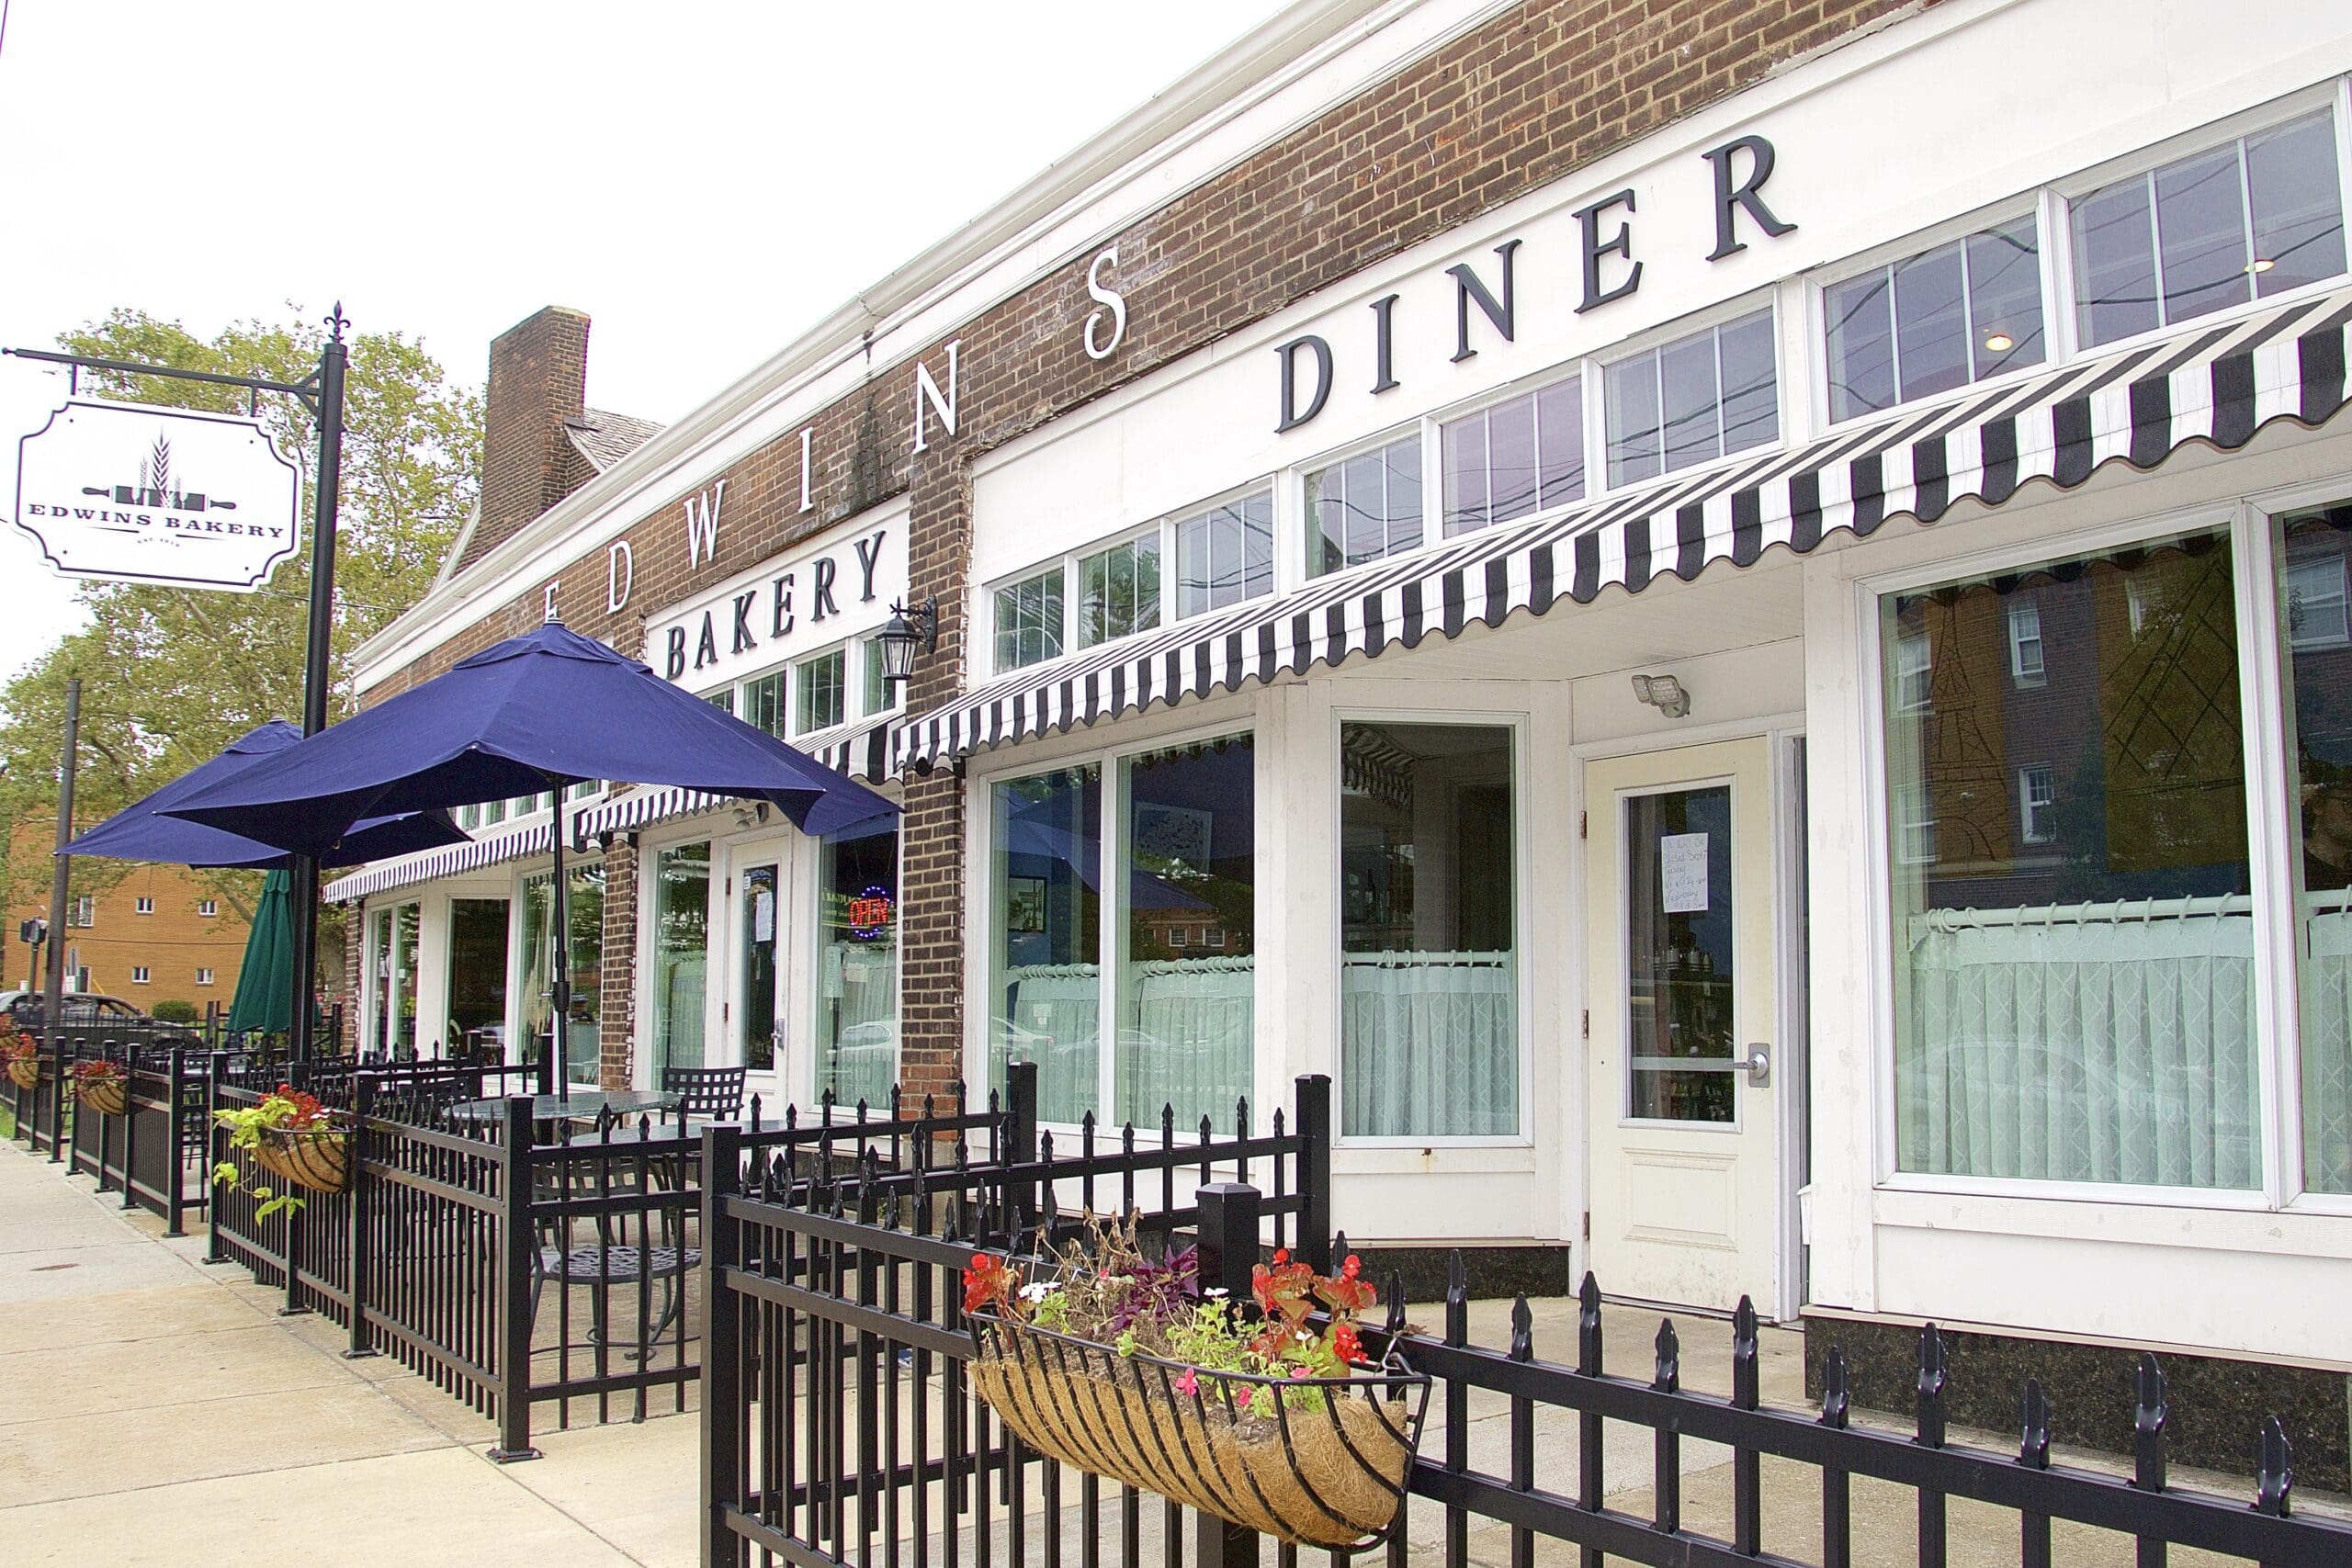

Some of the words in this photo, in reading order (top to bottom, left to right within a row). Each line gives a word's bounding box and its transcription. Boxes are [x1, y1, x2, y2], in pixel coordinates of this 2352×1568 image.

[1273, 135, 1798, 434] DINER
[544, 247, 1126, 627] EDWINS
[28, 504, 151, 526] EDWINS
[165, 517, 284, 538] BAKERY
[666, 530, 886, 679] BAKERY
[850, 898, 888, 926] OPEN
